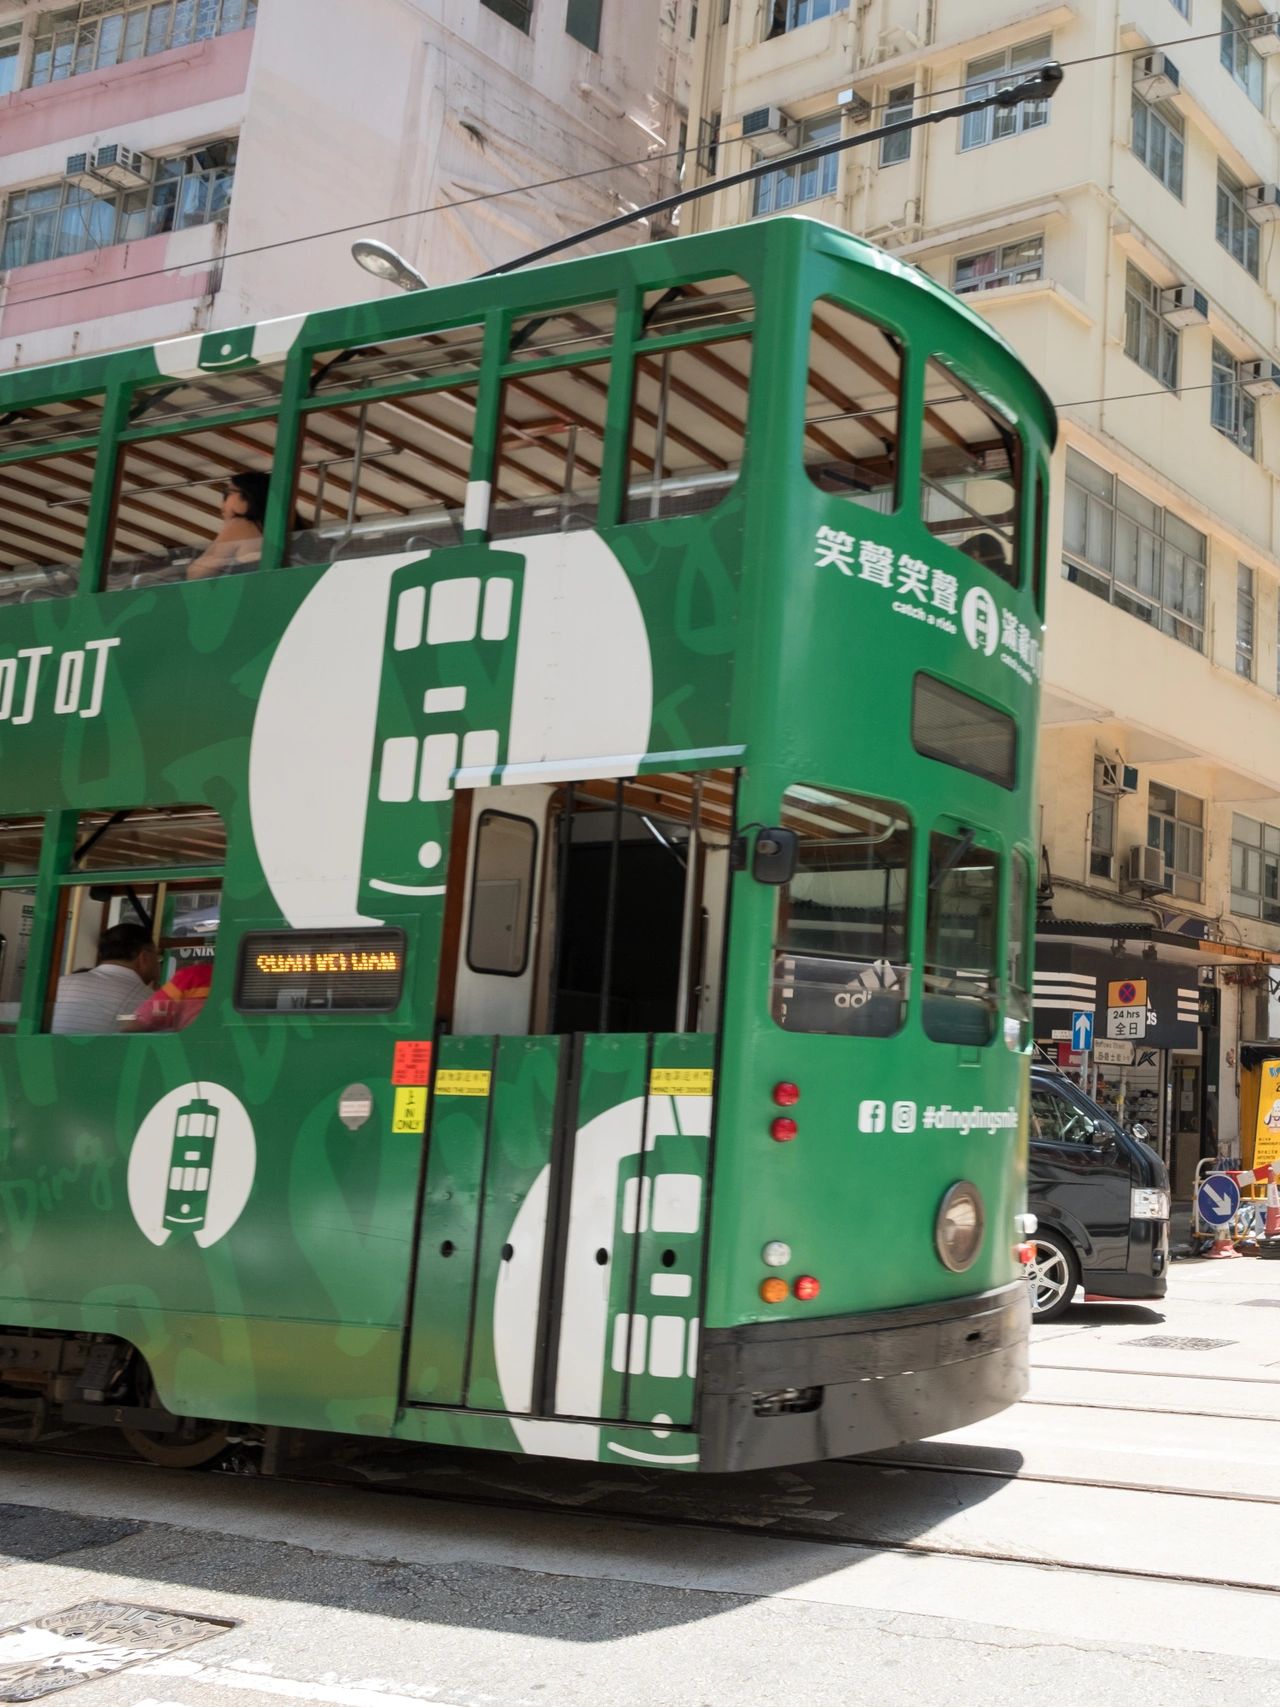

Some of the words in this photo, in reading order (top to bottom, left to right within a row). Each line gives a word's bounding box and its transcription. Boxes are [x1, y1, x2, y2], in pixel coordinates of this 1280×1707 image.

[814, 525, 959, 615] 笑聲笑聲
[892, 601, 926, 621] catch
[926, 614, 936, 625] a
[935, 617, 958, 634] ride
[1113, 1010, 1124, 1019] 24
[1126, 1010, 1140, 1019] hrs
[1115, 1022, 1138, 1036] 全日
